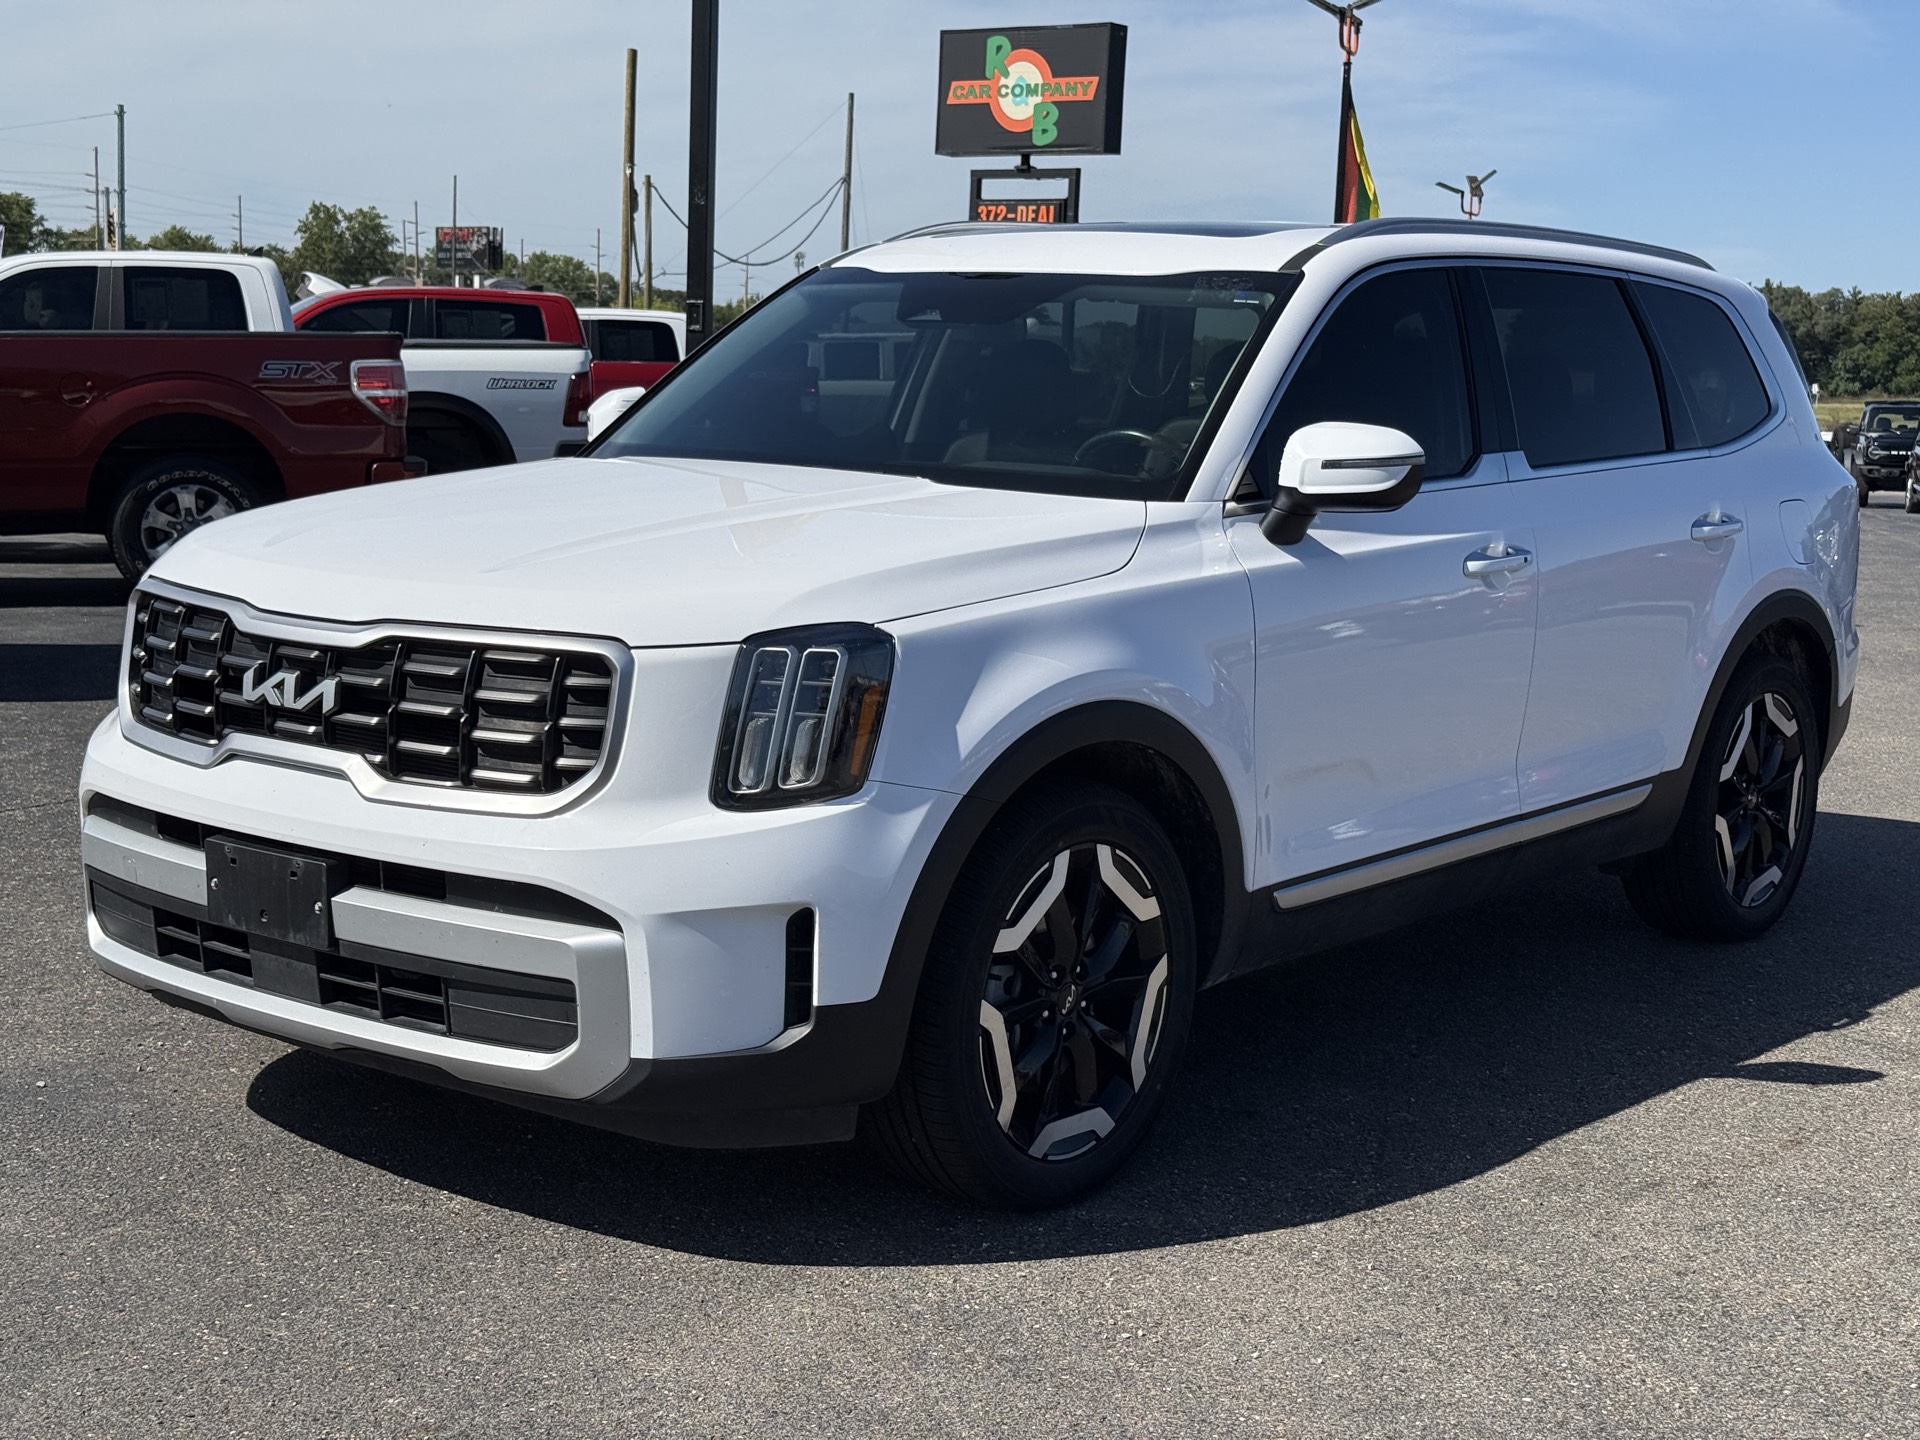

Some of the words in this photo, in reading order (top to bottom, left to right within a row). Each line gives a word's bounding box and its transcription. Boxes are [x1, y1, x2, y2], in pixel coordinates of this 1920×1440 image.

[952, 84, 992, 99] CAR
[997, 81, 1093, 98] COMPANY
[985, 35, 1012, 79] R
[1032, 102, 1059, 147] B
[259, 361, 343, 379] STX
[486, 378, 557, 390] WARLOCK
[242, 660, 342, 716] KIA
